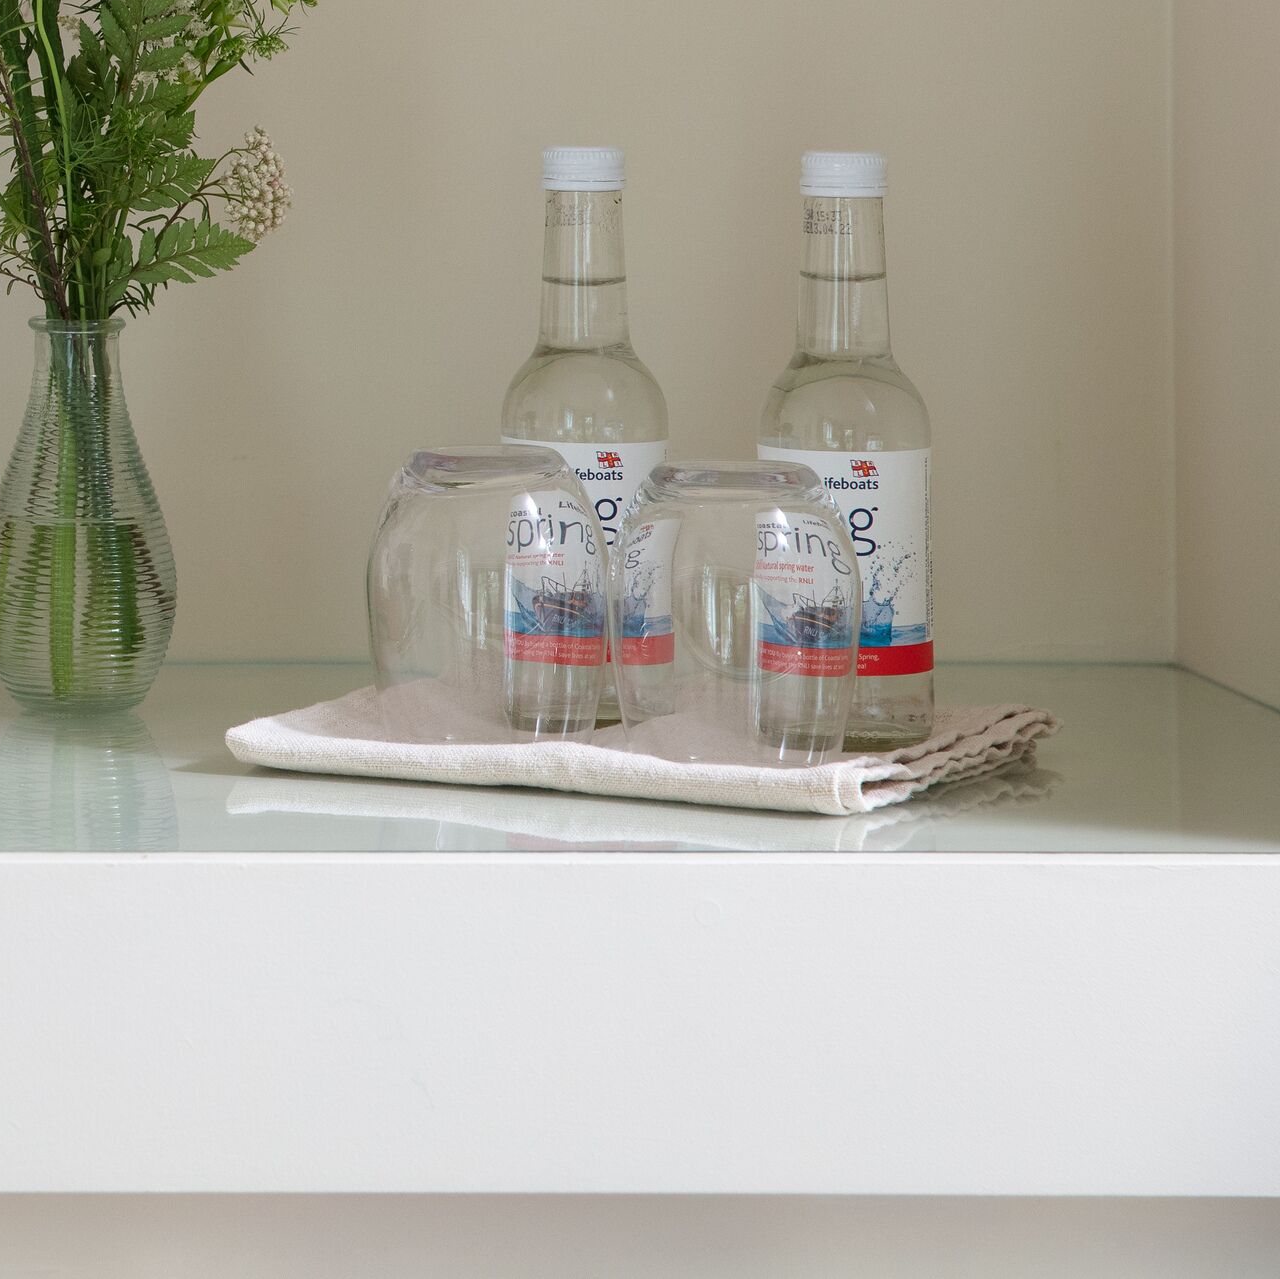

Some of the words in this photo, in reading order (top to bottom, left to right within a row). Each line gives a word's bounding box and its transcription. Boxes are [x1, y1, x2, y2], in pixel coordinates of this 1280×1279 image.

[507, 514, 597, 555] spring
[779, 562, 795, 574] spring
[796, 564, 814, 573] water
[798, 576, 815, 585] RNLI
[858, 653, 880, 662] Spring,
